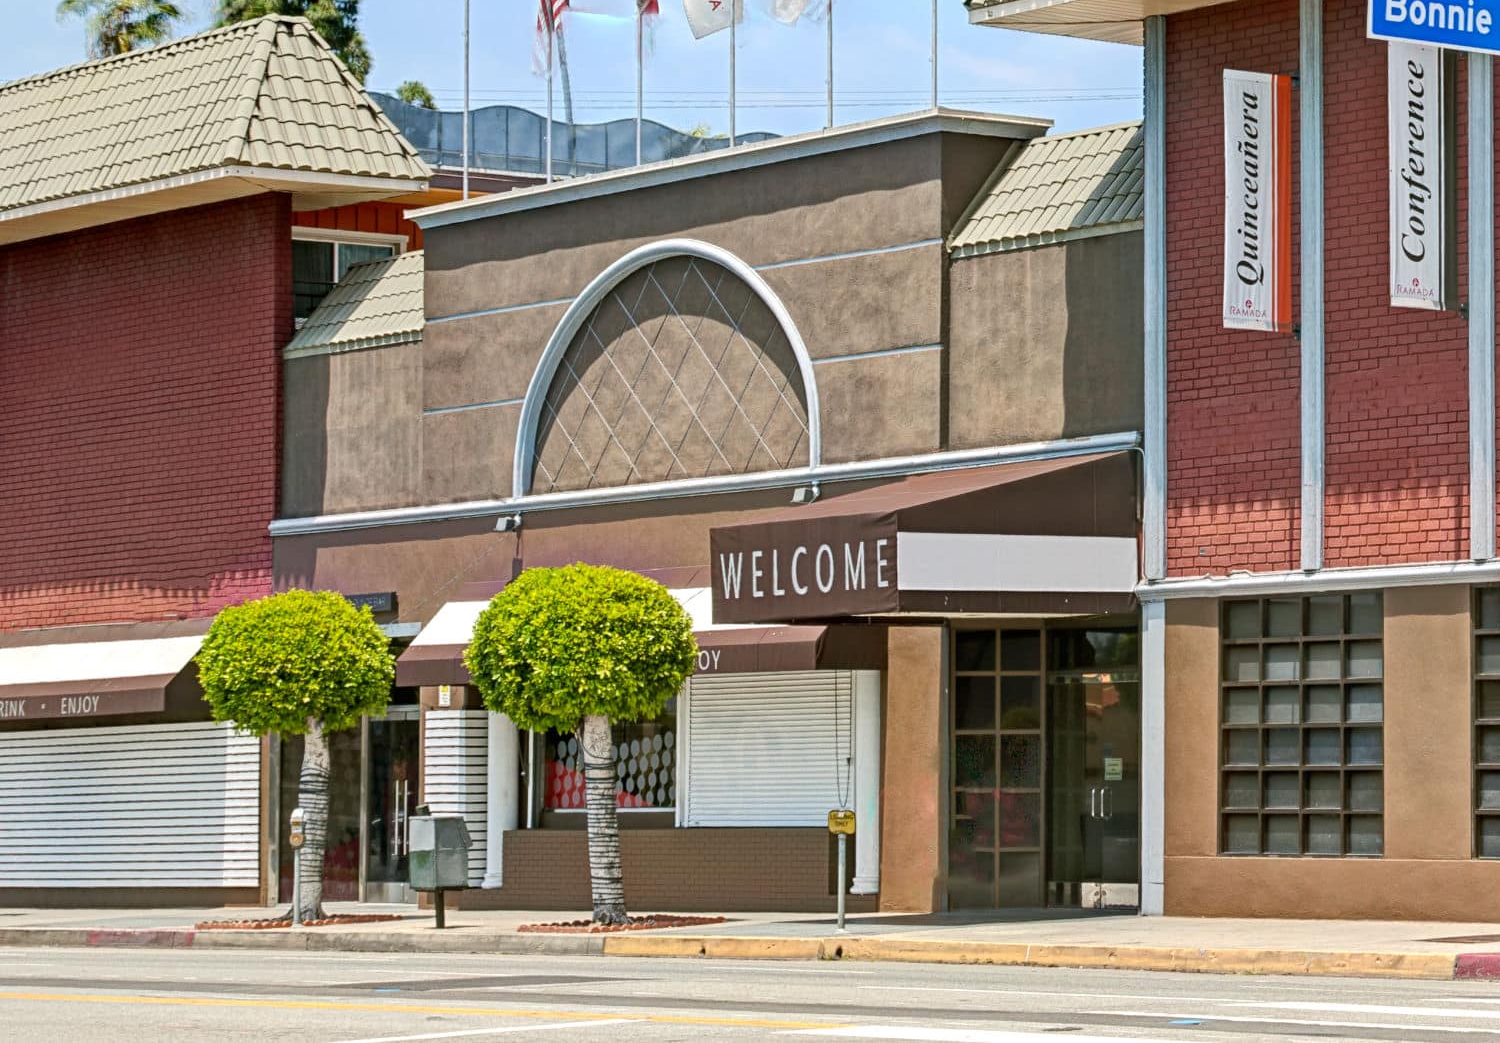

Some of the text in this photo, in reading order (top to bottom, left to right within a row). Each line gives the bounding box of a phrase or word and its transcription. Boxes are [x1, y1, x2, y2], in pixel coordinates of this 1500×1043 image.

[1401, 58, 1432, 263] Conference
[1236, 90, 1265, 287] Quinceañera
[1396, 283, 1435, 298] RAMADA
[1229, 305, 1267, 319] RAMADA
[720, 539, 889, 600] WELCOME
[61, 695, 100, 715] ENJOY
